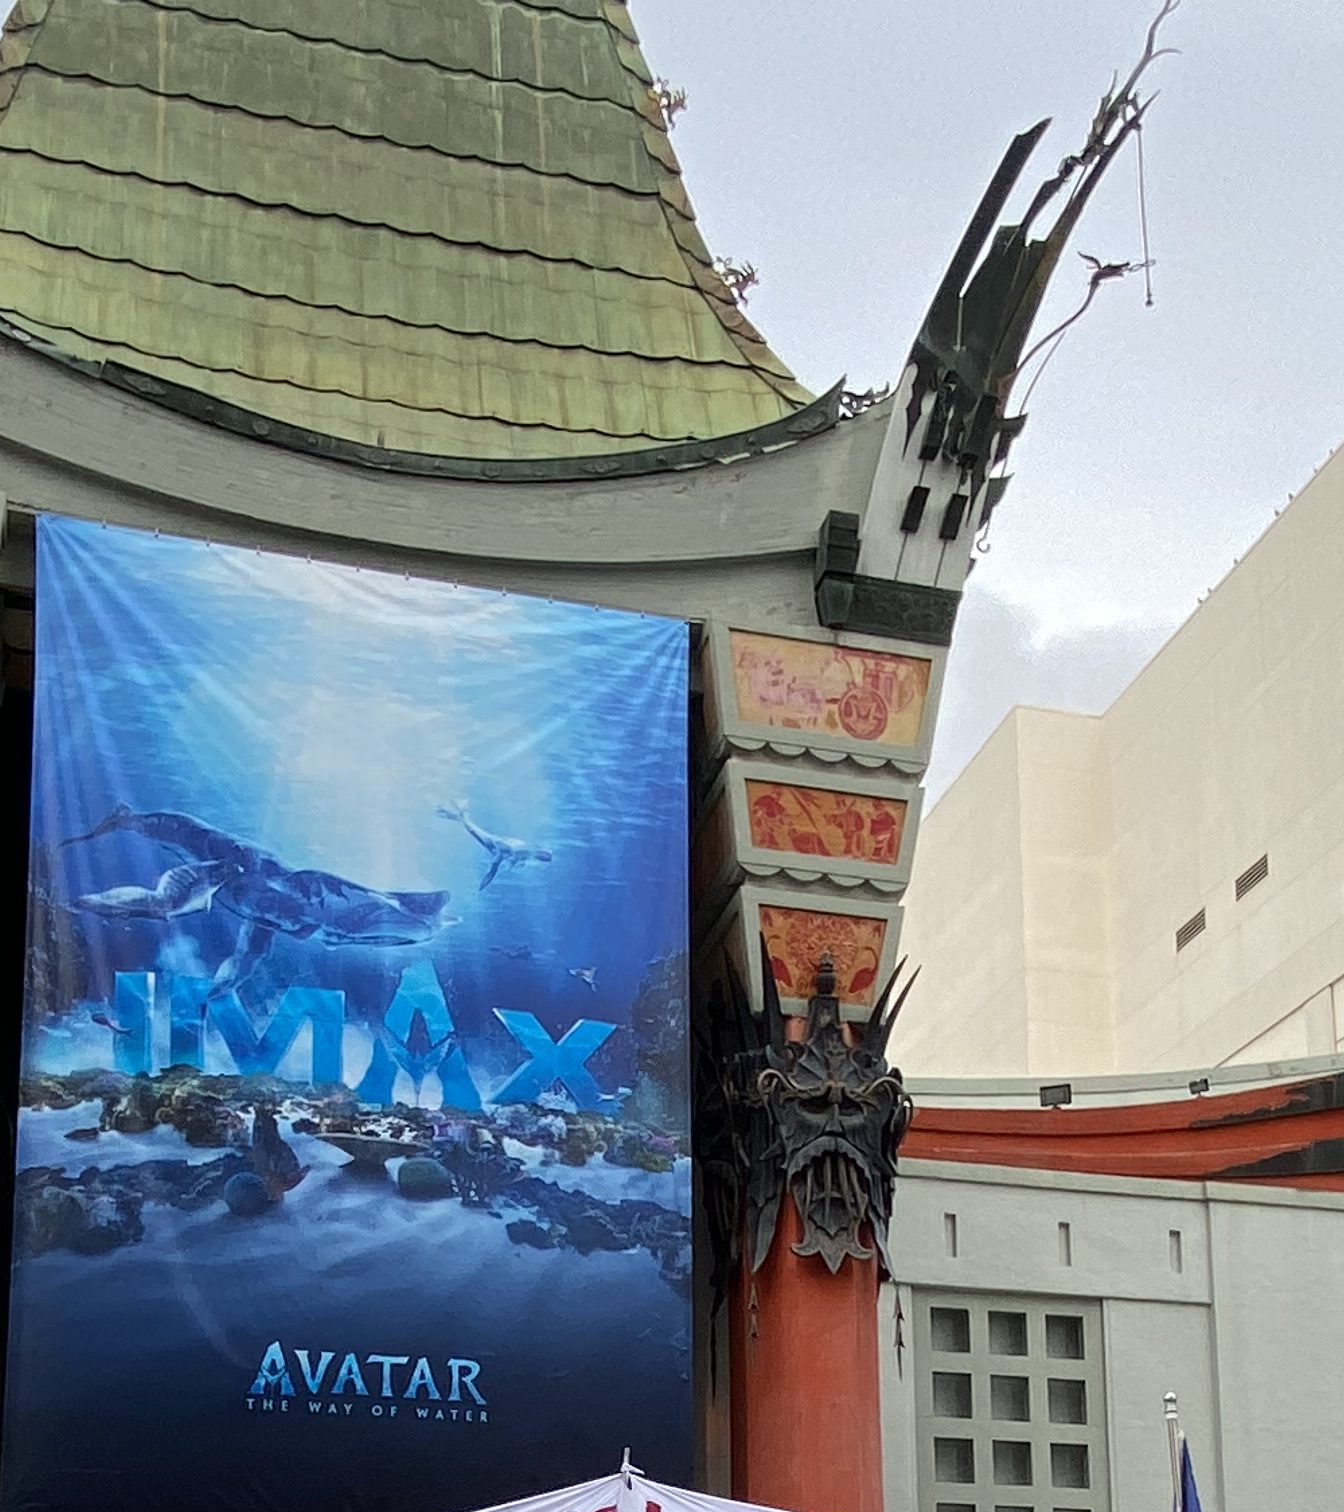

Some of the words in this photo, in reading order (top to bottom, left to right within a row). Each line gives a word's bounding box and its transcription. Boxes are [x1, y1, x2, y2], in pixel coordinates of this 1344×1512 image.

[114, 959, 618, 1112] IMAX
[249, 1340, 487, 1406] AVATAR
[247, 1397, 290, 1413] THE
[308, 1401, 354, 1418] WAY
[370, 1404, 400, 1419] OF
[415, 1406, 490, 1424] WATER
